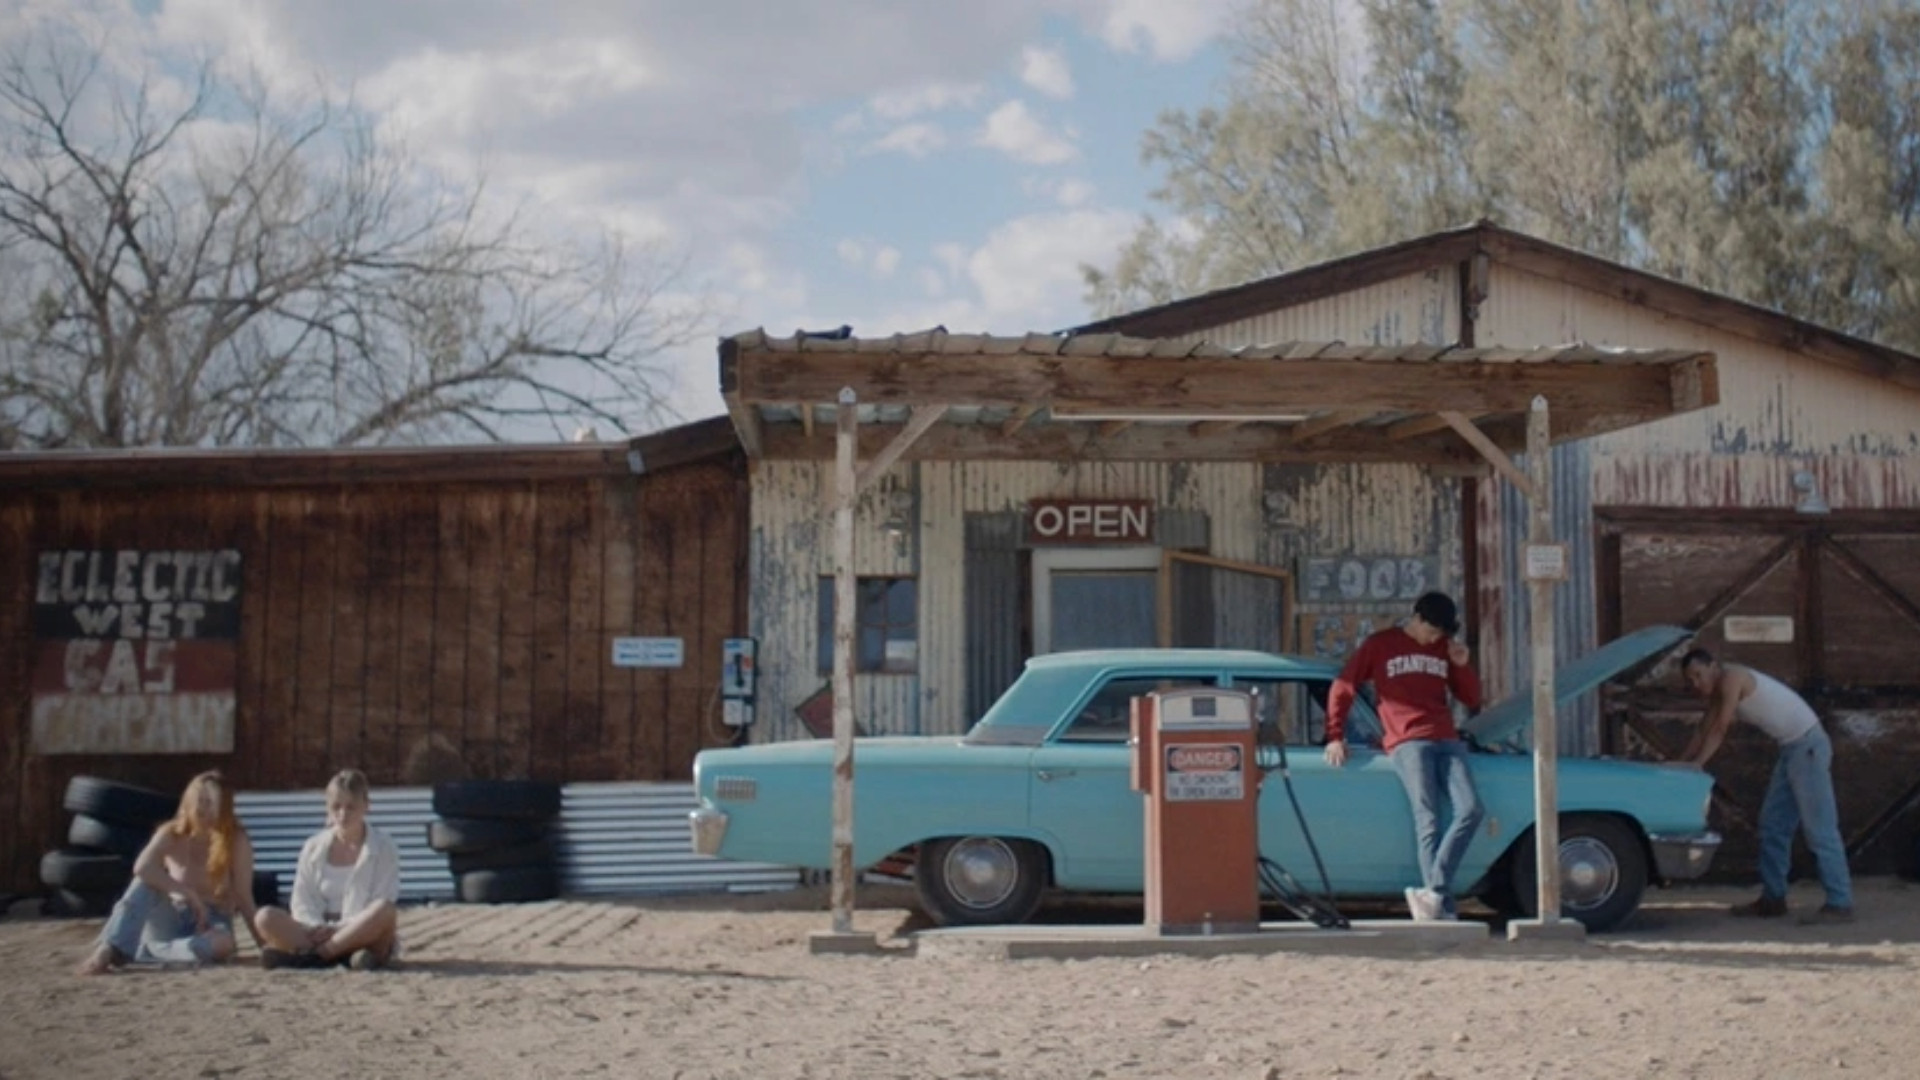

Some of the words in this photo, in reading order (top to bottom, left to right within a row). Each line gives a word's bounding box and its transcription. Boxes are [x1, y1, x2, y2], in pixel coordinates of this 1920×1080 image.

[1034, 505, 1147, 537] OPEN
[36, 549, 242, 604] ECLECTIC
[73, 602, 205, 638] WEST
[64, 638, 176, 694] GAS
[33, 693, 236, 752] COMPANY
[1173, 751, 1235, 767] DANGER
